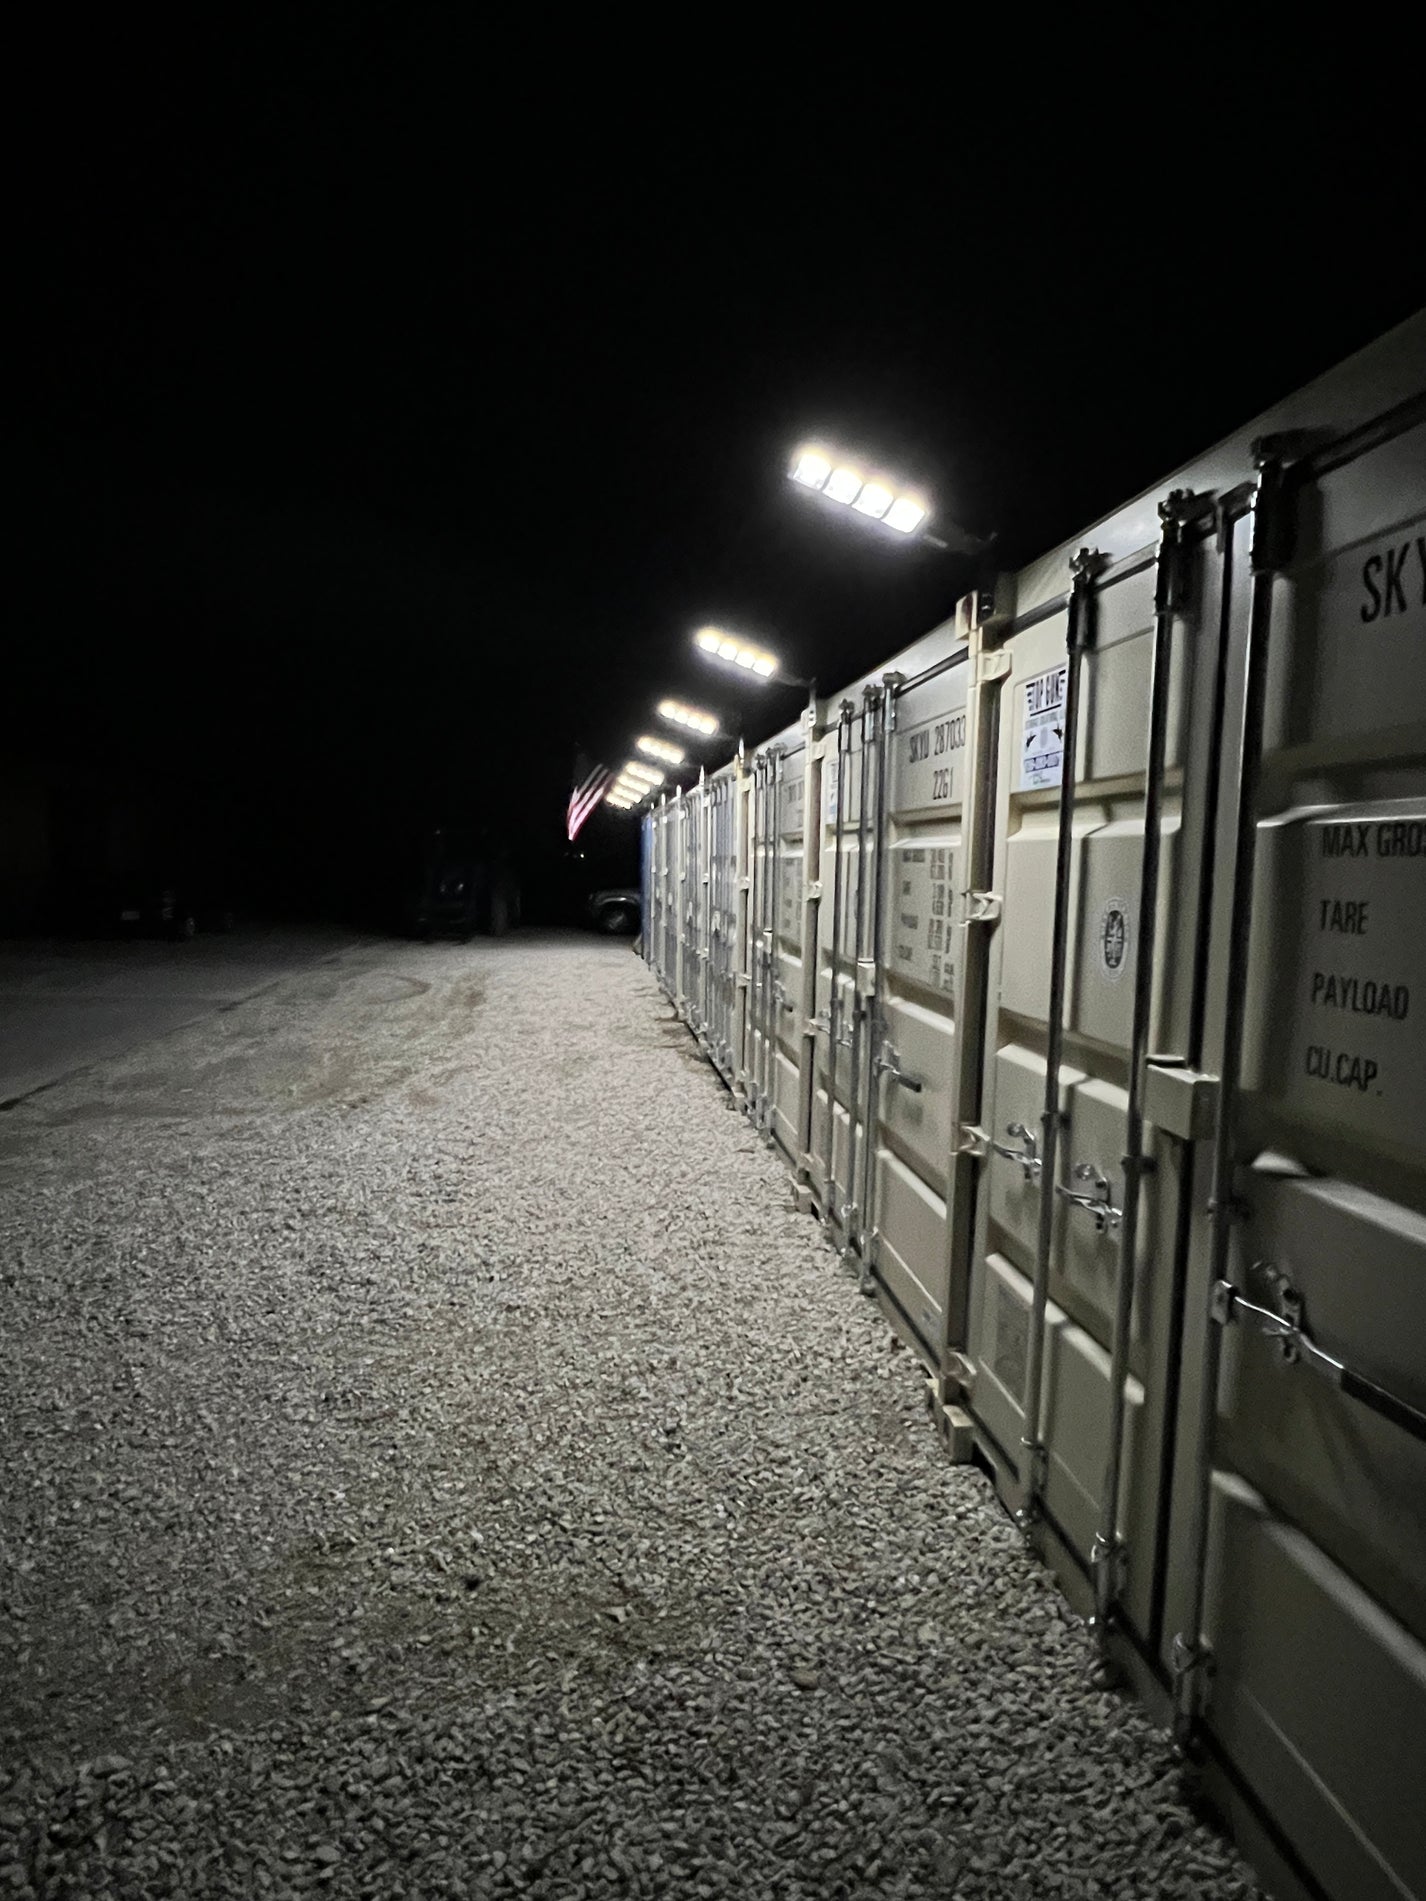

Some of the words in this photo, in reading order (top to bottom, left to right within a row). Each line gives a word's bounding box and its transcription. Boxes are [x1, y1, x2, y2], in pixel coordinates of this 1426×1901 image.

[1321, 825, 1369, 857] MAX
[1319, 900, 1369, 934] TARE
[1310, 972, 1409, 1020] PAYLOAD
